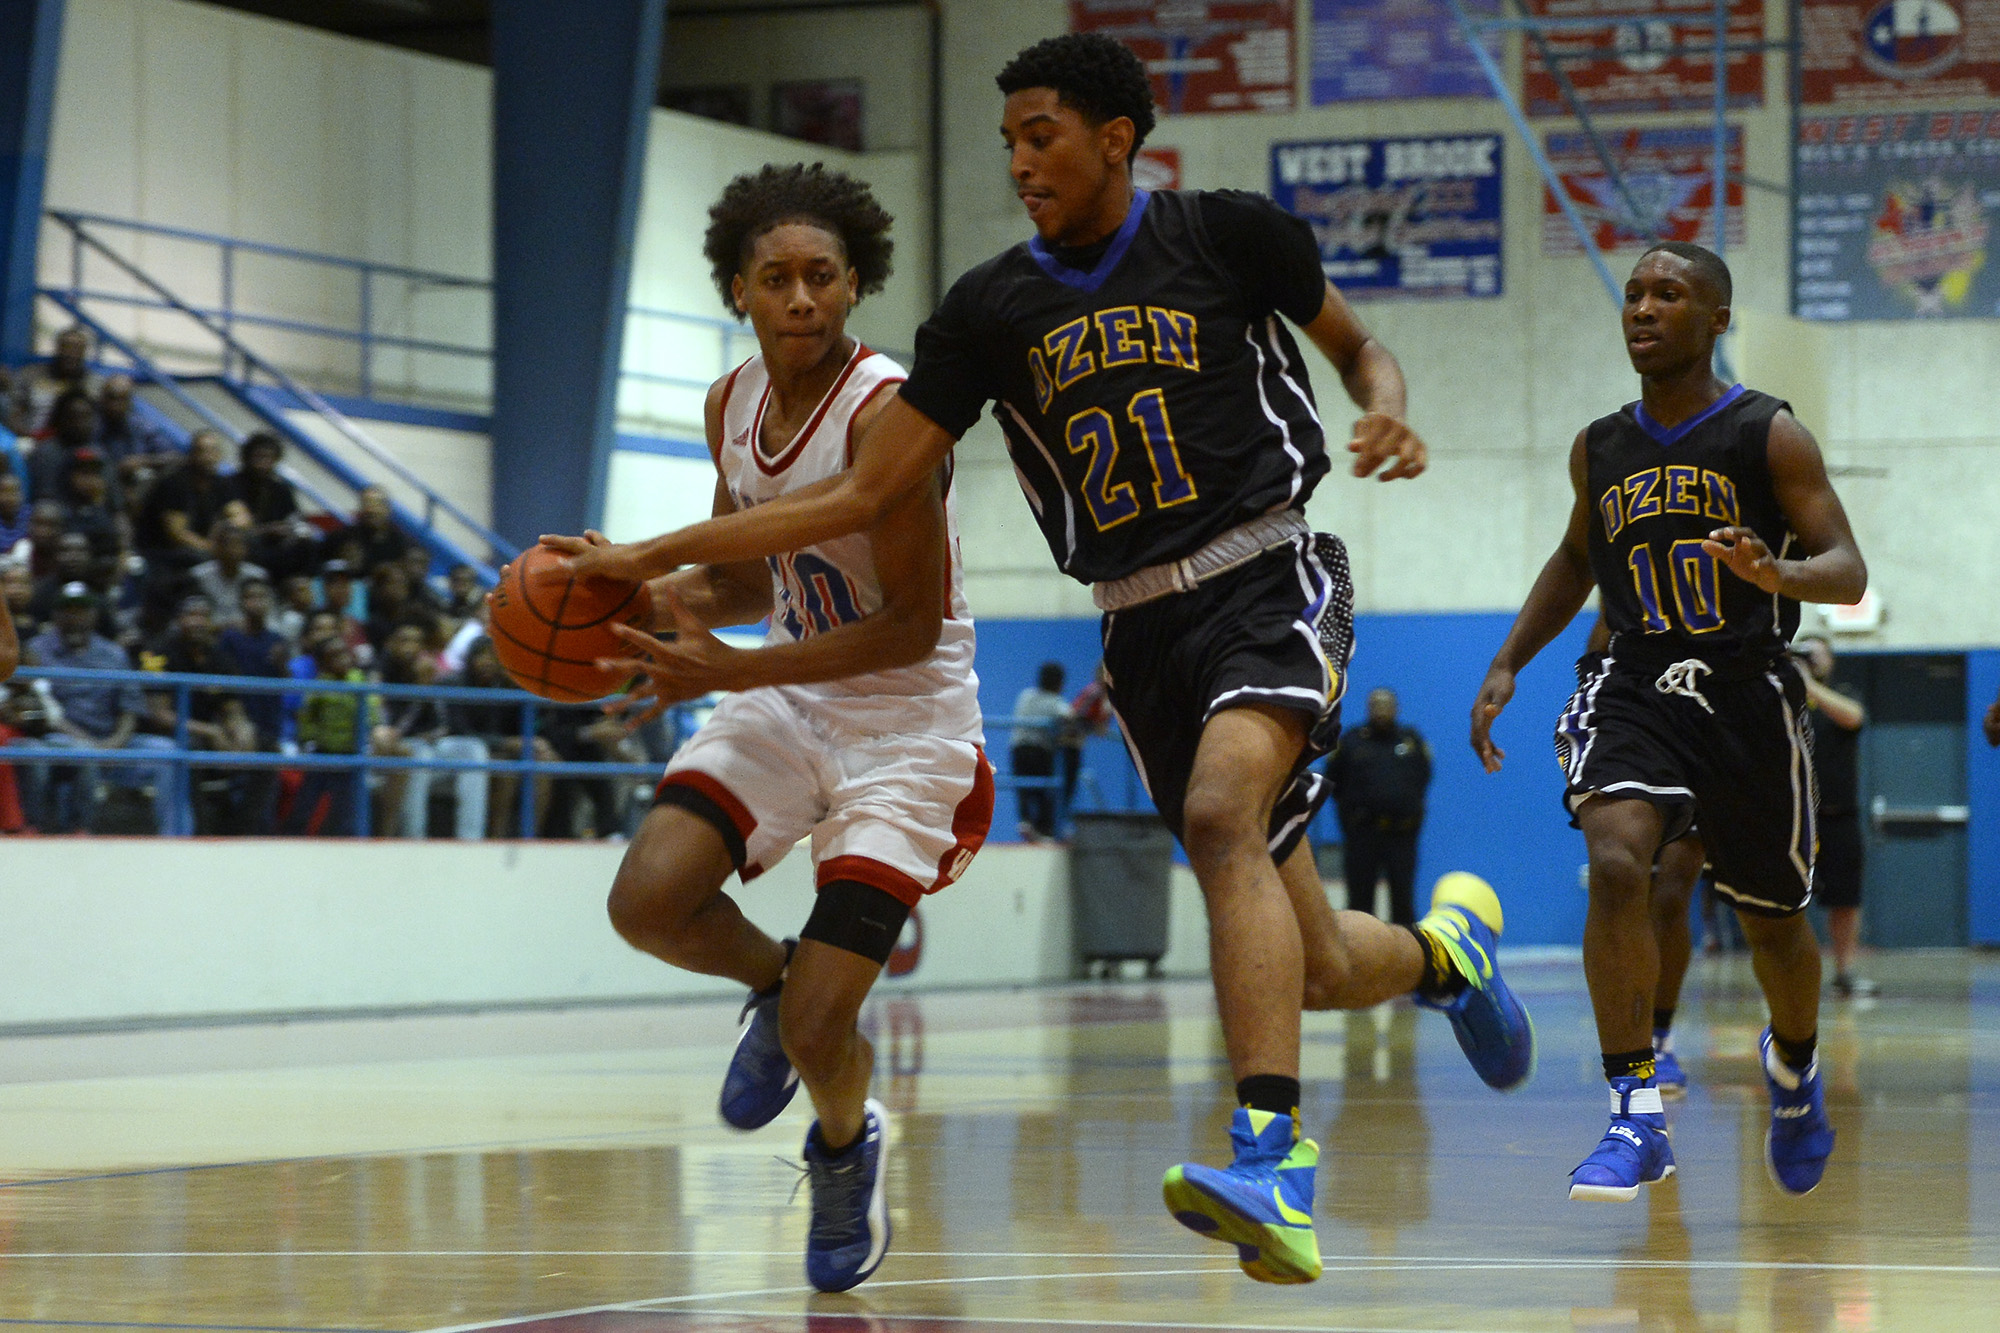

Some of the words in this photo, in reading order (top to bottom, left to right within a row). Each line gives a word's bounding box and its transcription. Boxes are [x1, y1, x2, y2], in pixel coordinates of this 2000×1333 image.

[1277, 144, 1373, 185] WEST
[1384, 138, 1498, 181] BROOK
[1028, 305, 1200, 414] OZEN
[1065, 388, 1199, 532] 21
[1599, 464, 1741, 543] OZEN
[1628, 538, 1726, 635] 10
